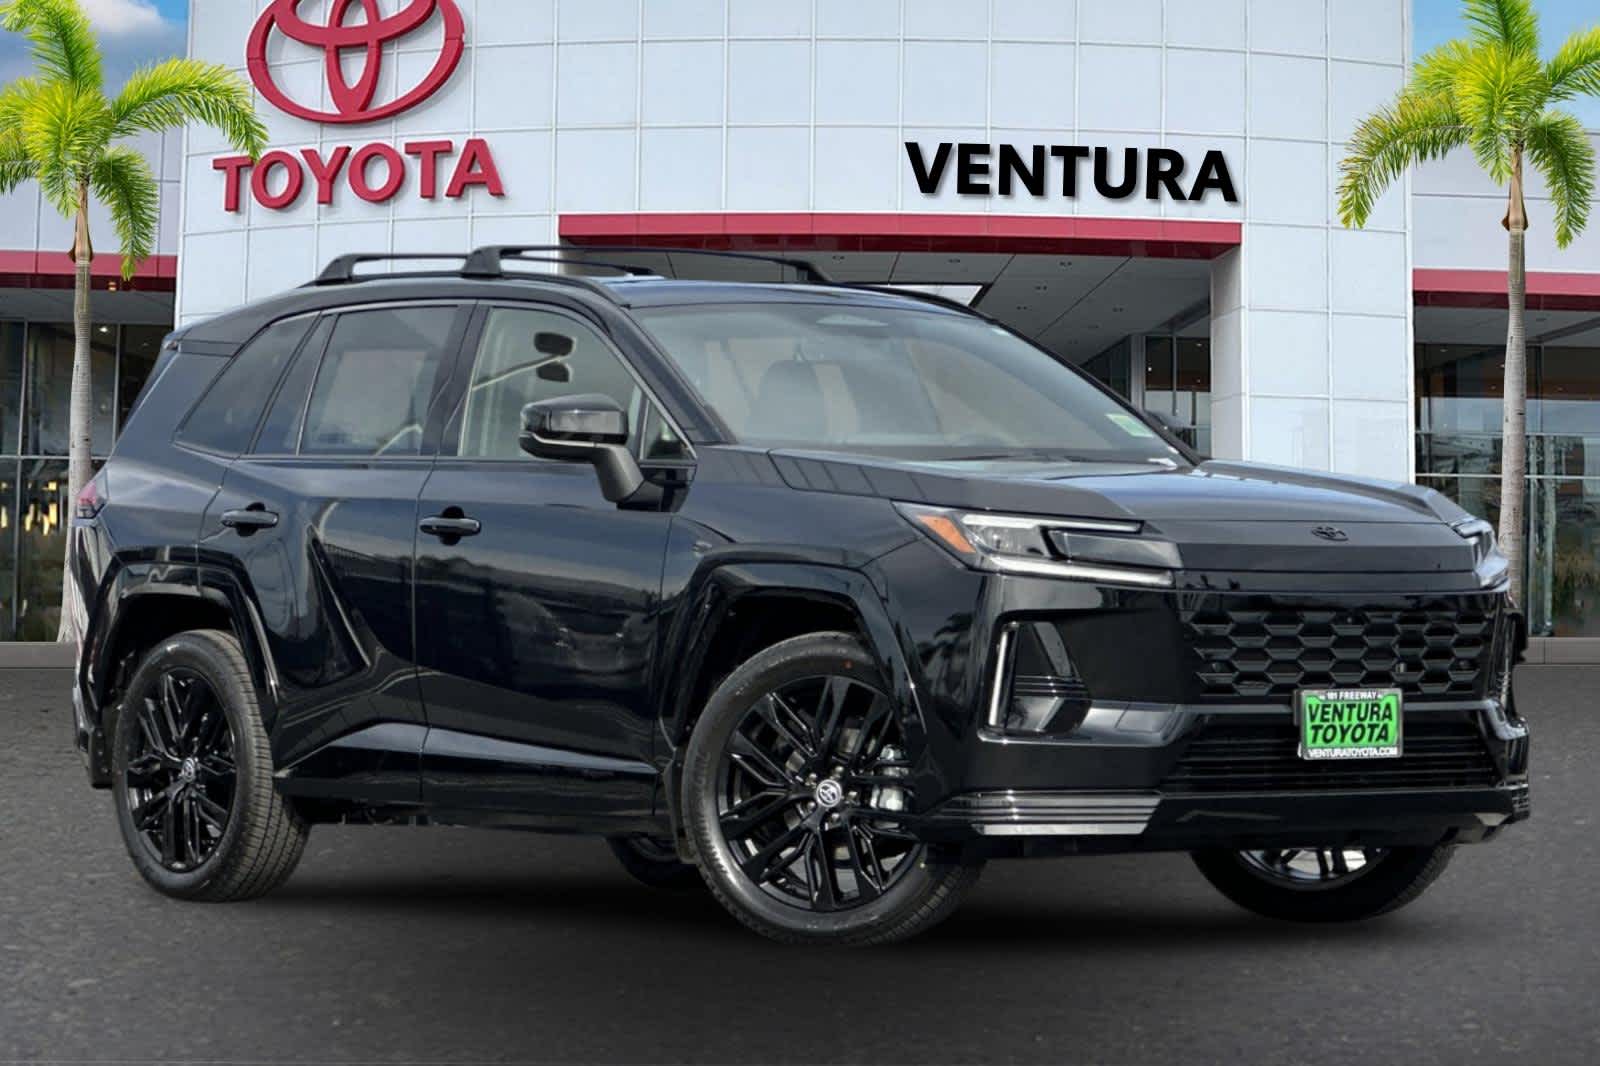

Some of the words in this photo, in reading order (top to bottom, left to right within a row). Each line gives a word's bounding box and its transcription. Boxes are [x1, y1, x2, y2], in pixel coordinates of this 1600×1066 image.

[212, 138, 505, 212] TOYOTA
[904, 142, 1238, 202] VENTURA
[1339, 691, 1377, 700] FREEWAY
[1308, 702, 1392, 723] VENTURA
[1310, 723, 1389, 744] TOYOTA
[1308, 746, 1398, 758] VENTURATOYOTA.COM
